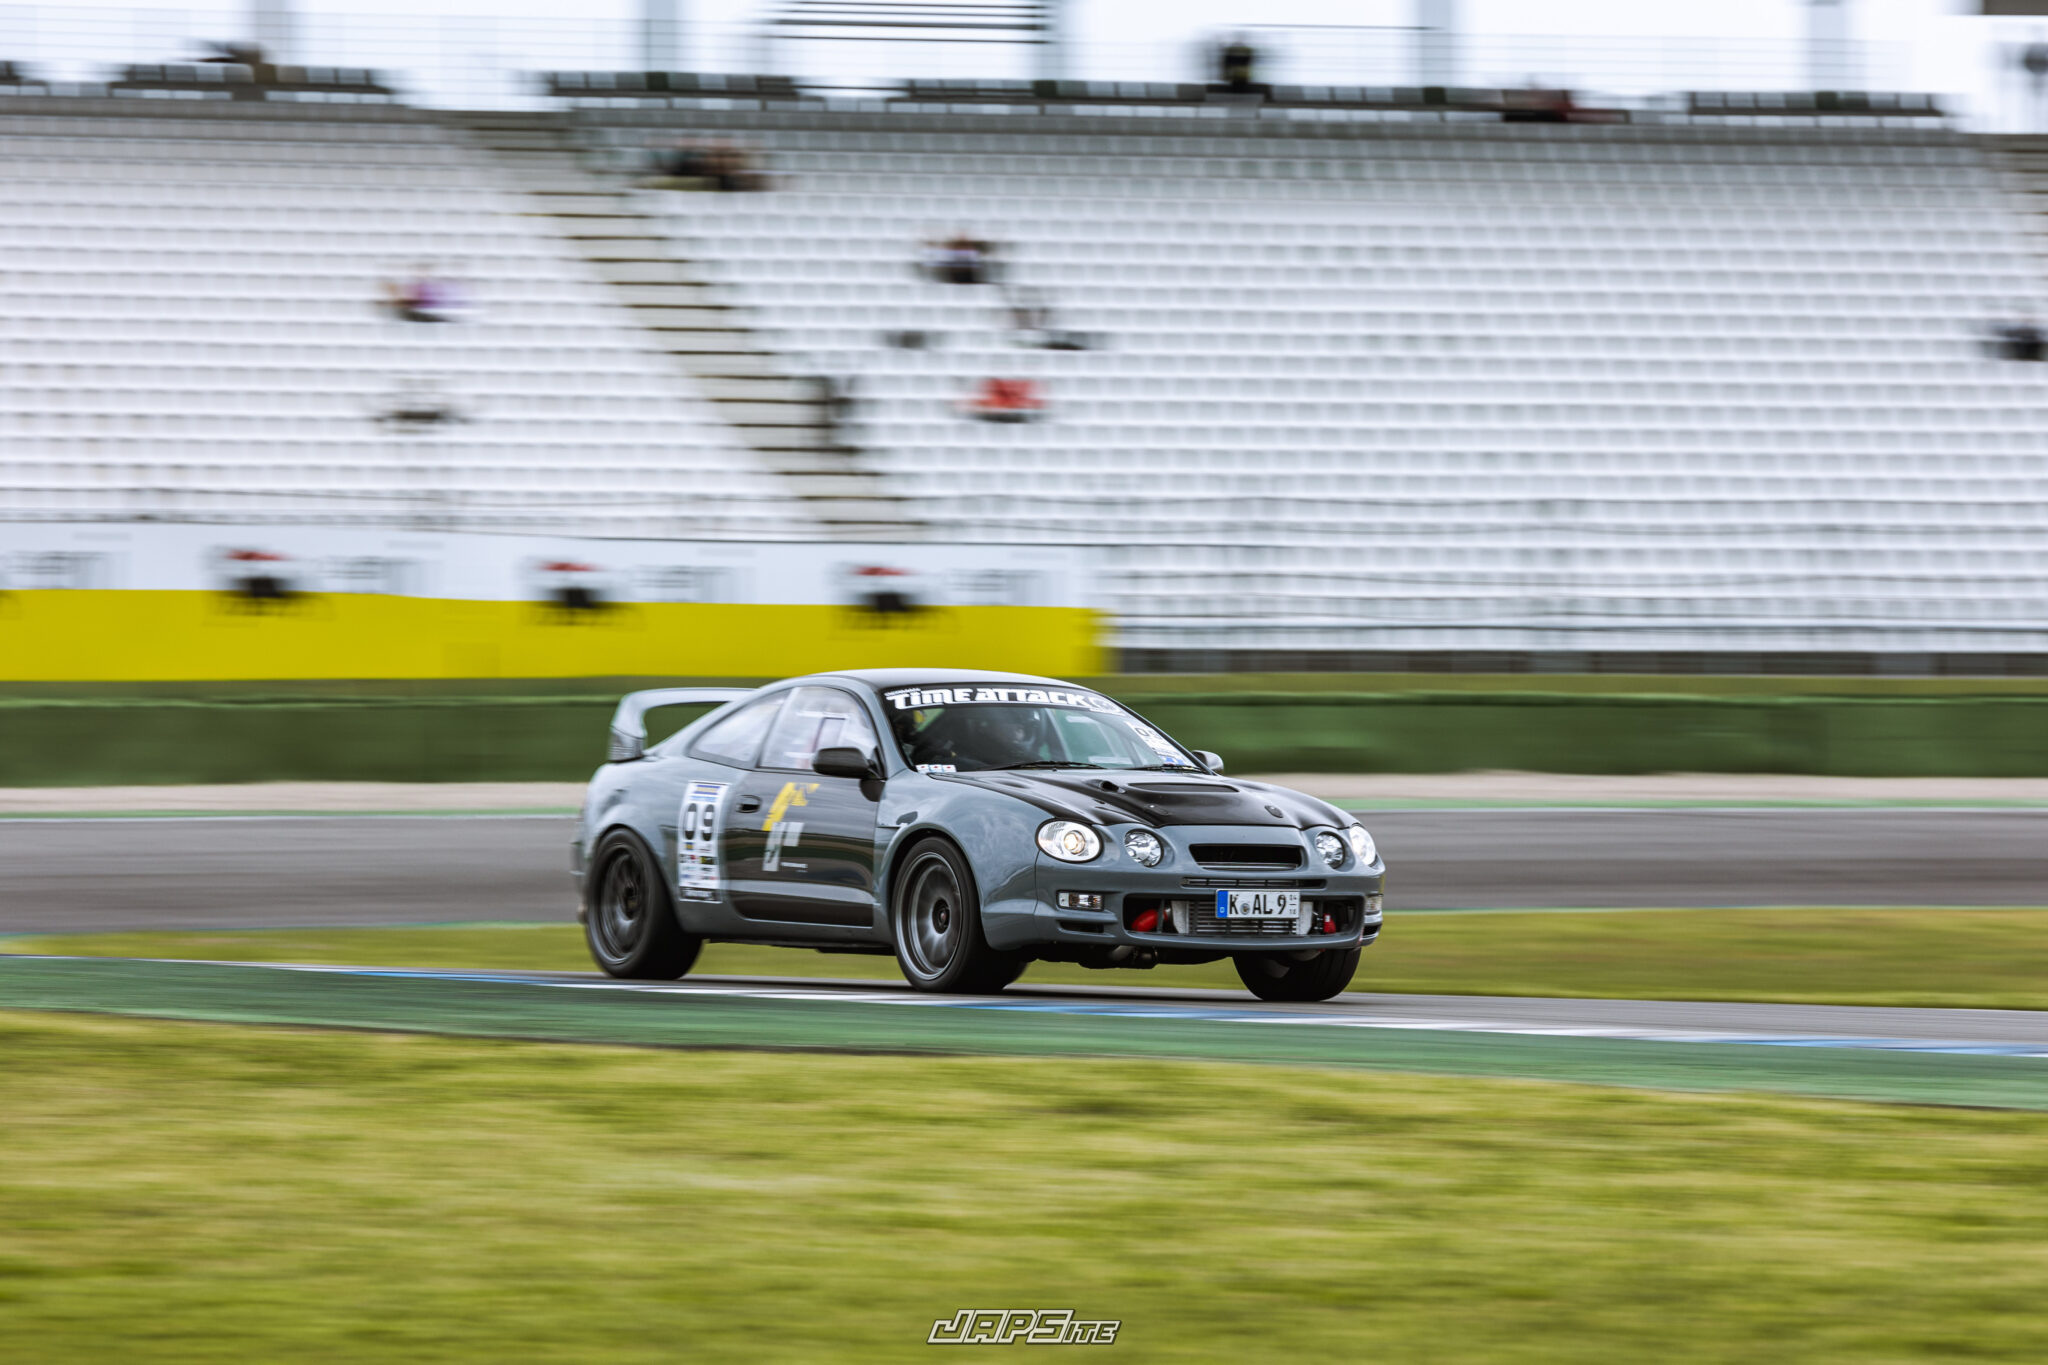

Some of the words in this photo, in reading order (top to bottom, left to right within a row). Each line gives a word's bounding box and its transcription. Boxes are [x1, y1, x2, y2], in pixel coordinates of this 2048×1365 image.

[682, 803, 716, 842] 09
[1229, 894, 1239, 915] K
[1252, 894, 1273, 915] AL
[1277, 895, 1287, 915] 9
